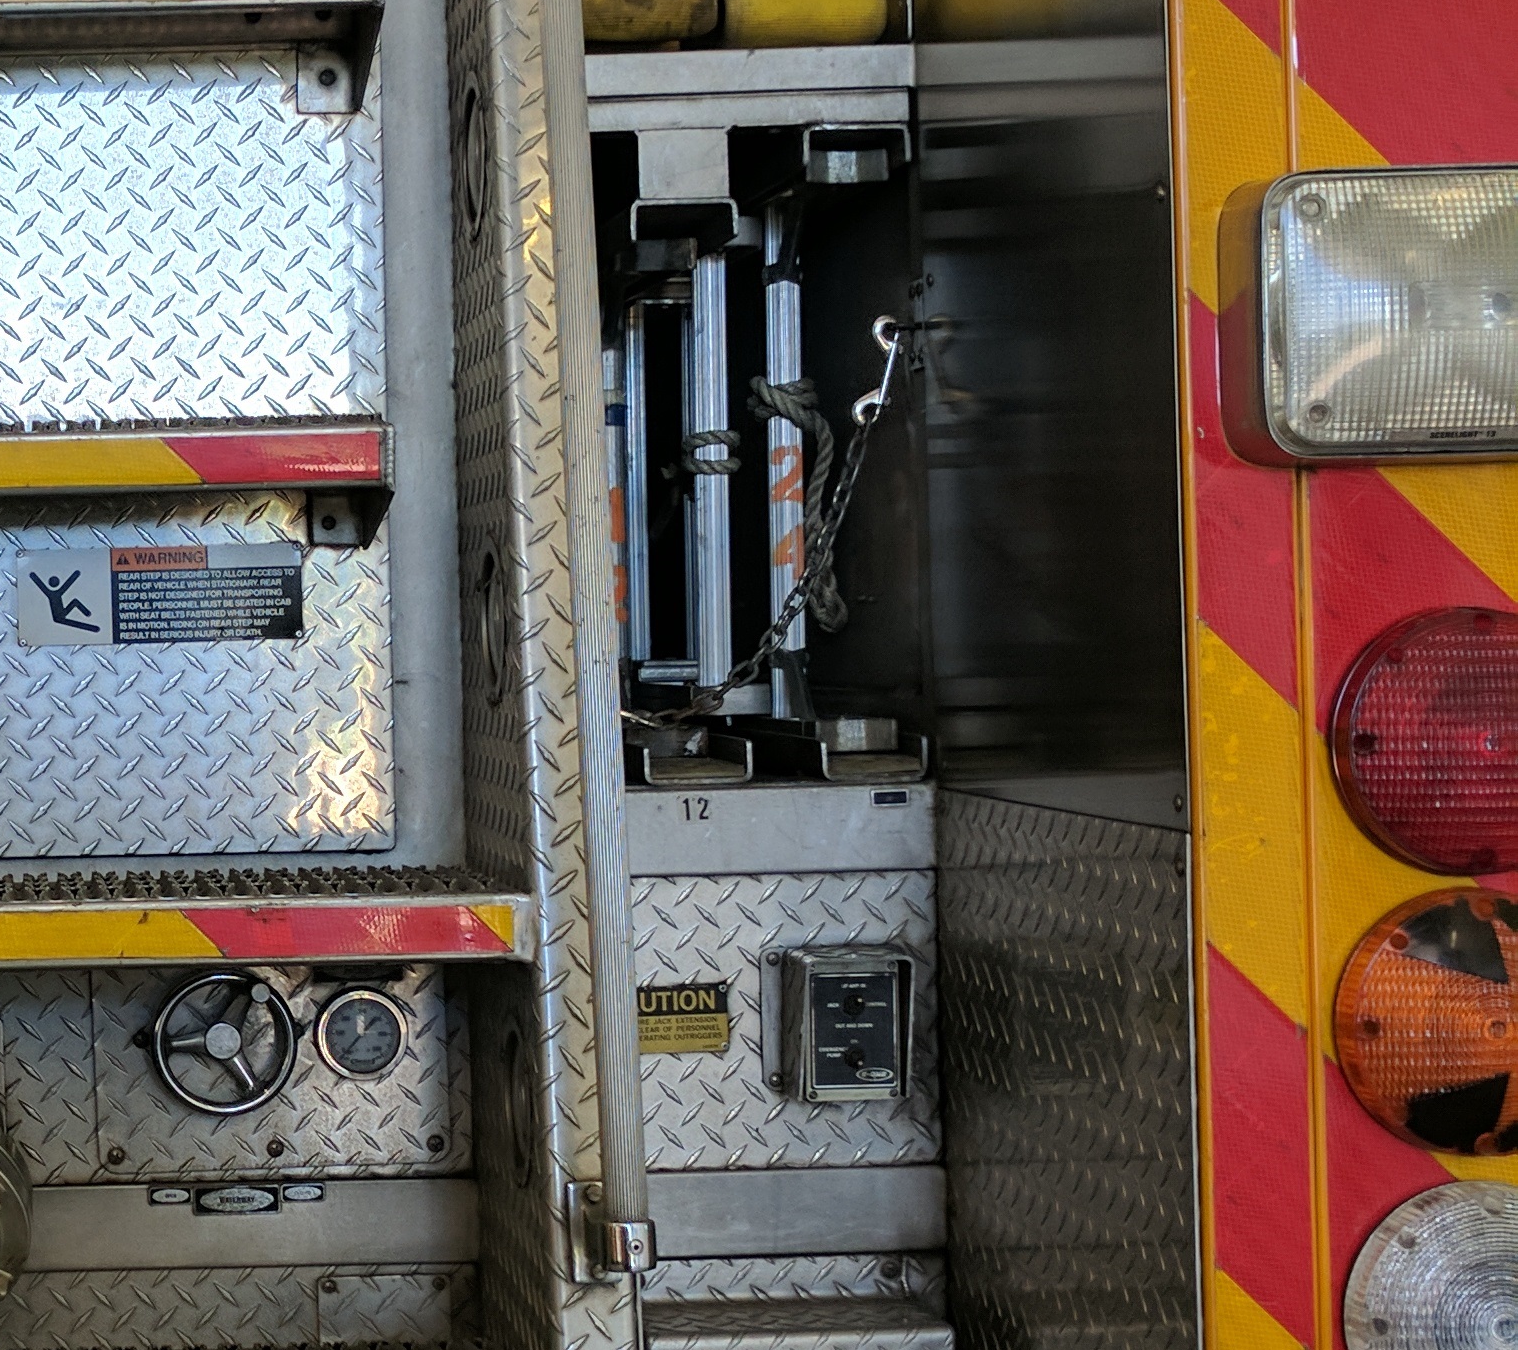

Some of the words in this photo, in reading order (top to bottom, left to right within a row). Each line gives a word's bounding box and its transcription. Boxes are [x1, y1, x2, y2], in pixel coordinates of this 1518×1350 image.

[134, 551, 204, 565] WARNING
[141, 572, 161, 580] STEP
[171, 571, 209, 579] DESIGNED
[211, 570, 222, 578] TO
[284, 568, 294, 576] TO
[166, 591, 204, 599] DESIGNED
[206, 590, 222, 598] FOR
[223, 589, 282, 597] TRANSPORTING
[200, 600, 222, 608] MUST
[275, 598, 291, 606] CAB
[227, 609, 251, 617] WHILE
[683, 798, 709, 820] 12
[639, 990, 716, 1012] UTION
[639, 1034, 671, 1042] ERATING
[674, 1032, 722, 1040] OUTRIGGERS
